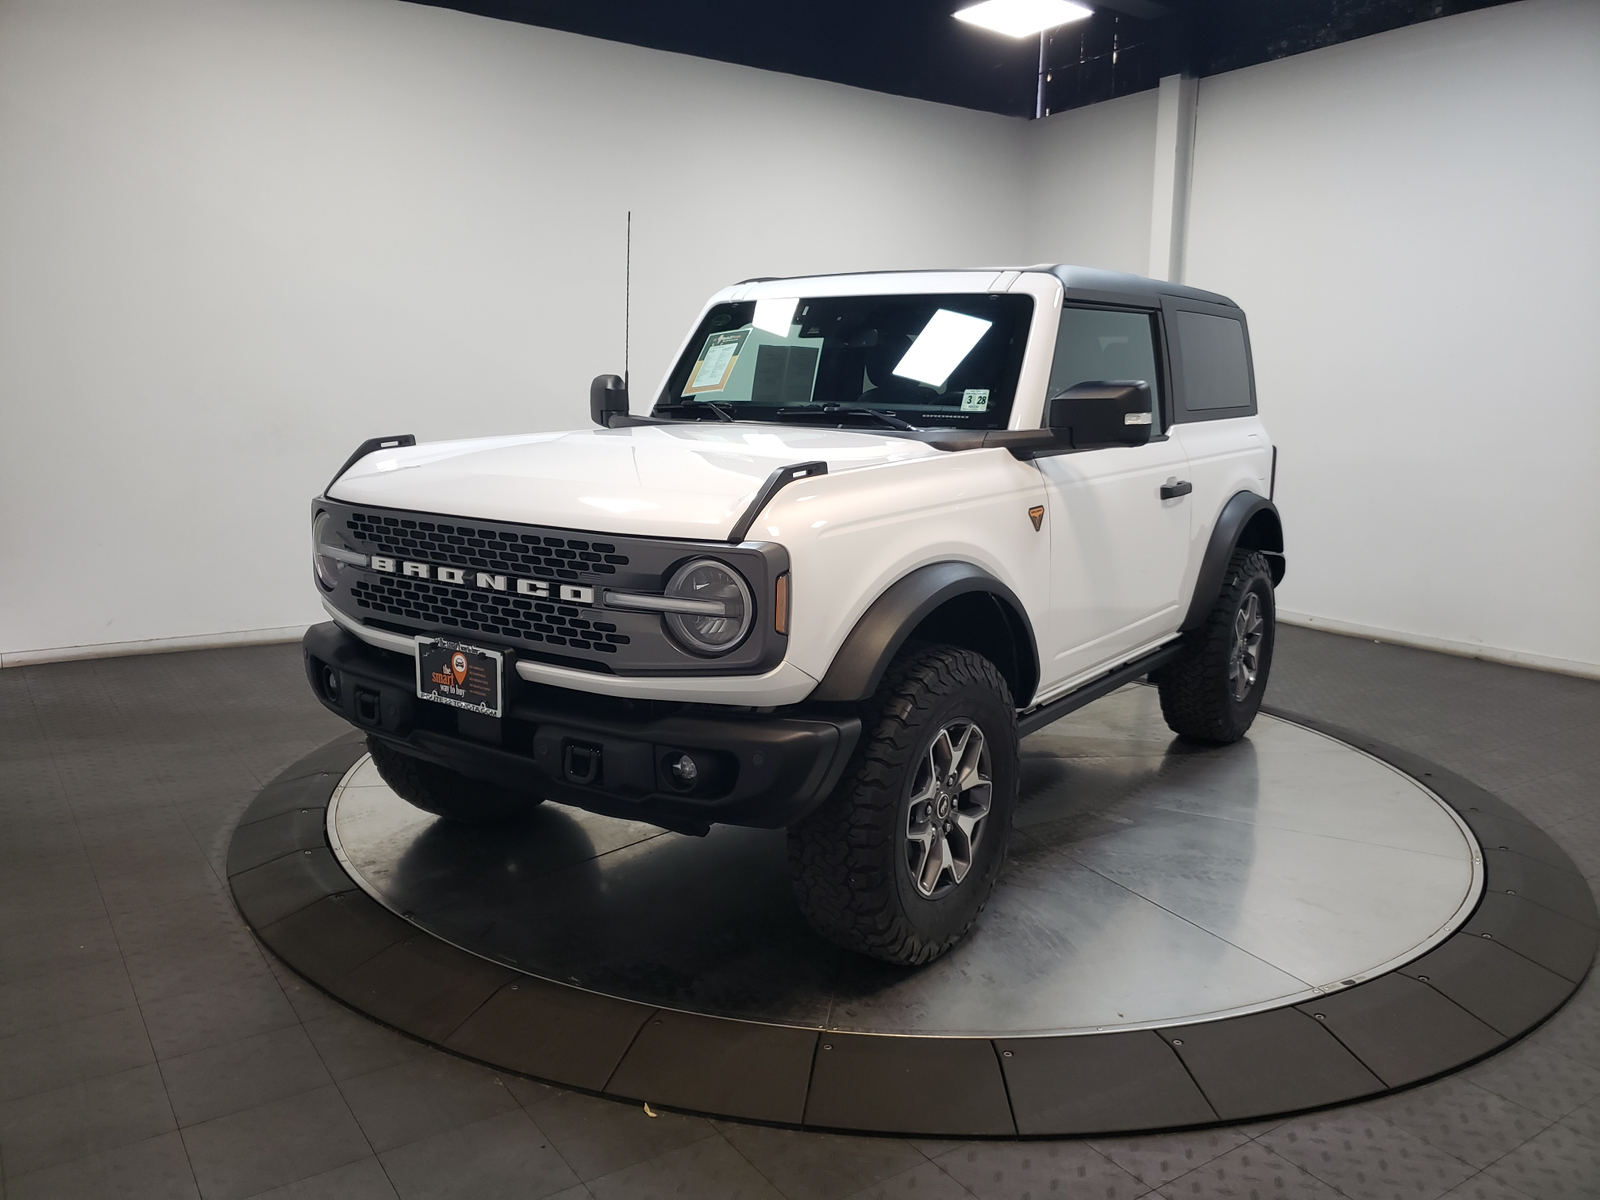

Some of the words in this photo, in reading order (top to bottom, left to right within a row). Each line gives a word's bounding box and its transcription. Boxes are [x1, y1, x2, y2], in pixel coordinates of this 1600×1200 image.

[967, 395, 973, 404] 3
[976, 395, 987, 405] 28
[371, 555, 595, 604] BRONCO
[443, 664, 451, 675] the
[432, 672, 454, 686] smart
[440, 685, 449, 695] way
[450, 685, 455, 695] to
[456, 685, 465, 698] buy
